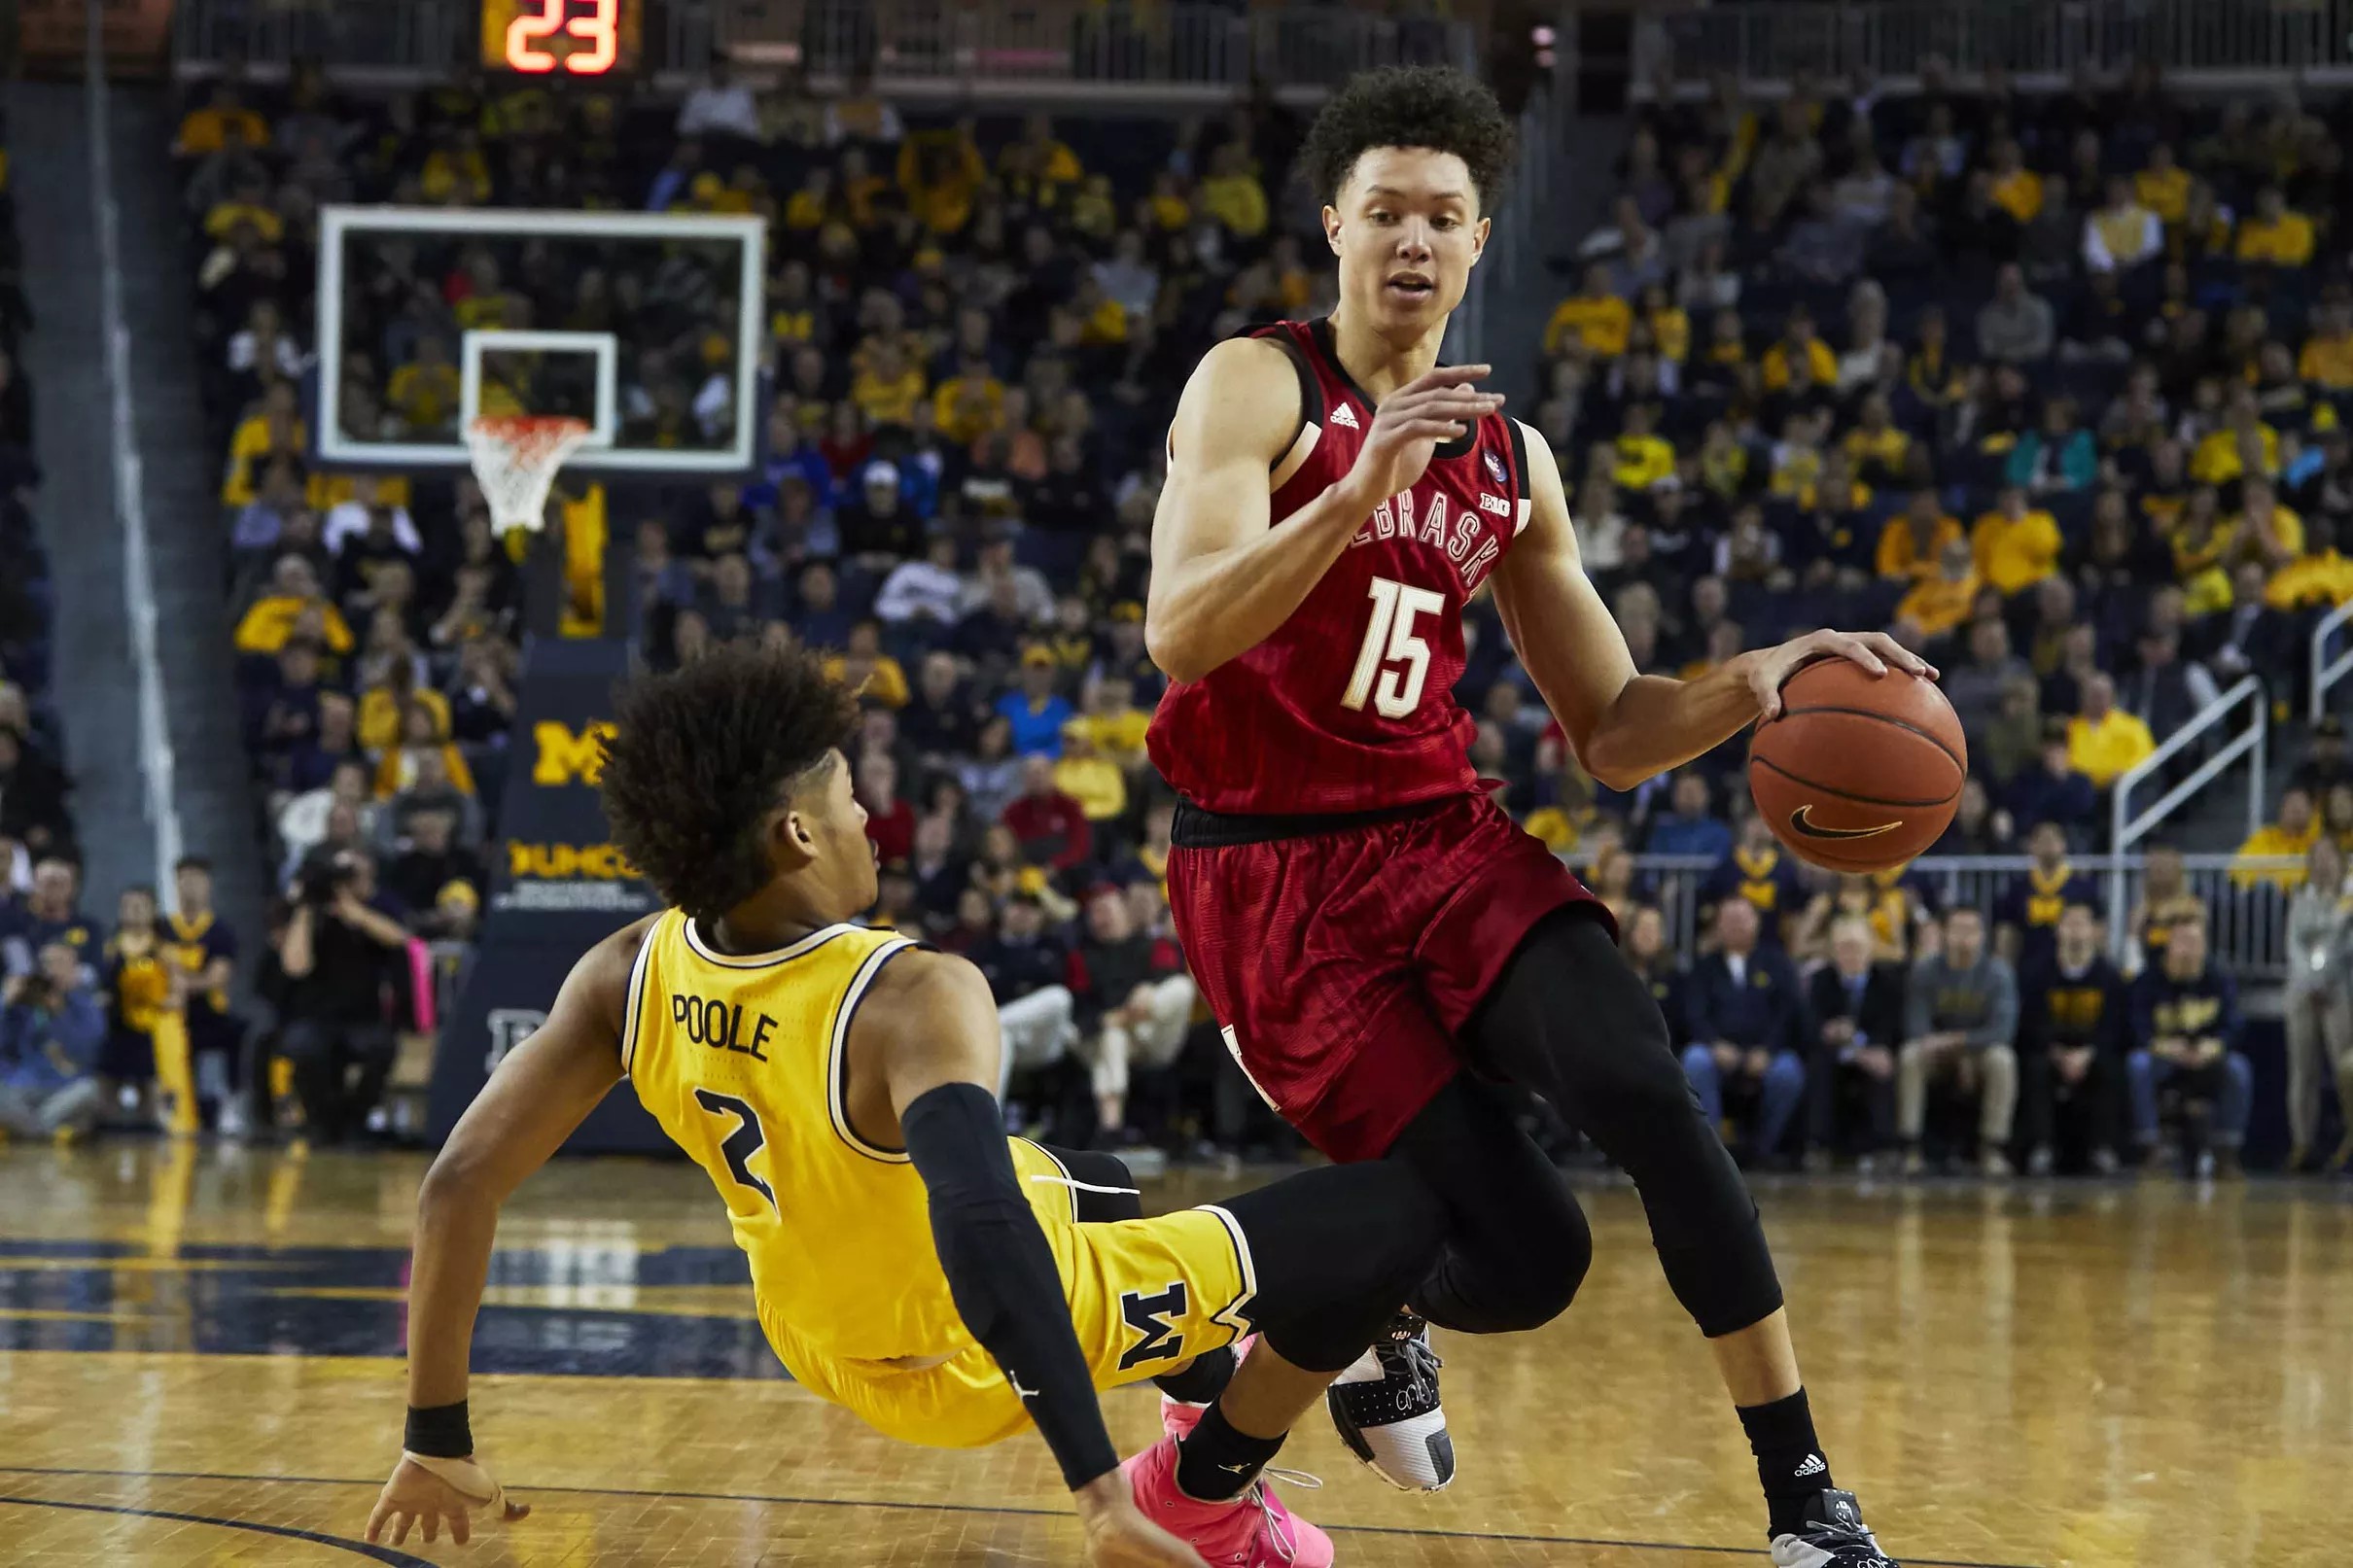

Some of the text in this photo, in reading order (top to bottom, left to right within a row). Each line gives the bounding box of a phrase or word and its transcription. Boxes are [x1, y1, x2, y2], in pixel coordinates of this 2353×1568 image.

[507, 0, 617, 74] 23
[1340, 575, 1446, 719] 15
[673, 994, 778, 1063] POOLE
[693, 1086, 779, 1216] 2
[1116, 1280, 1189, 1374] M
[1794, 1462, 1826, 1477] adidas
